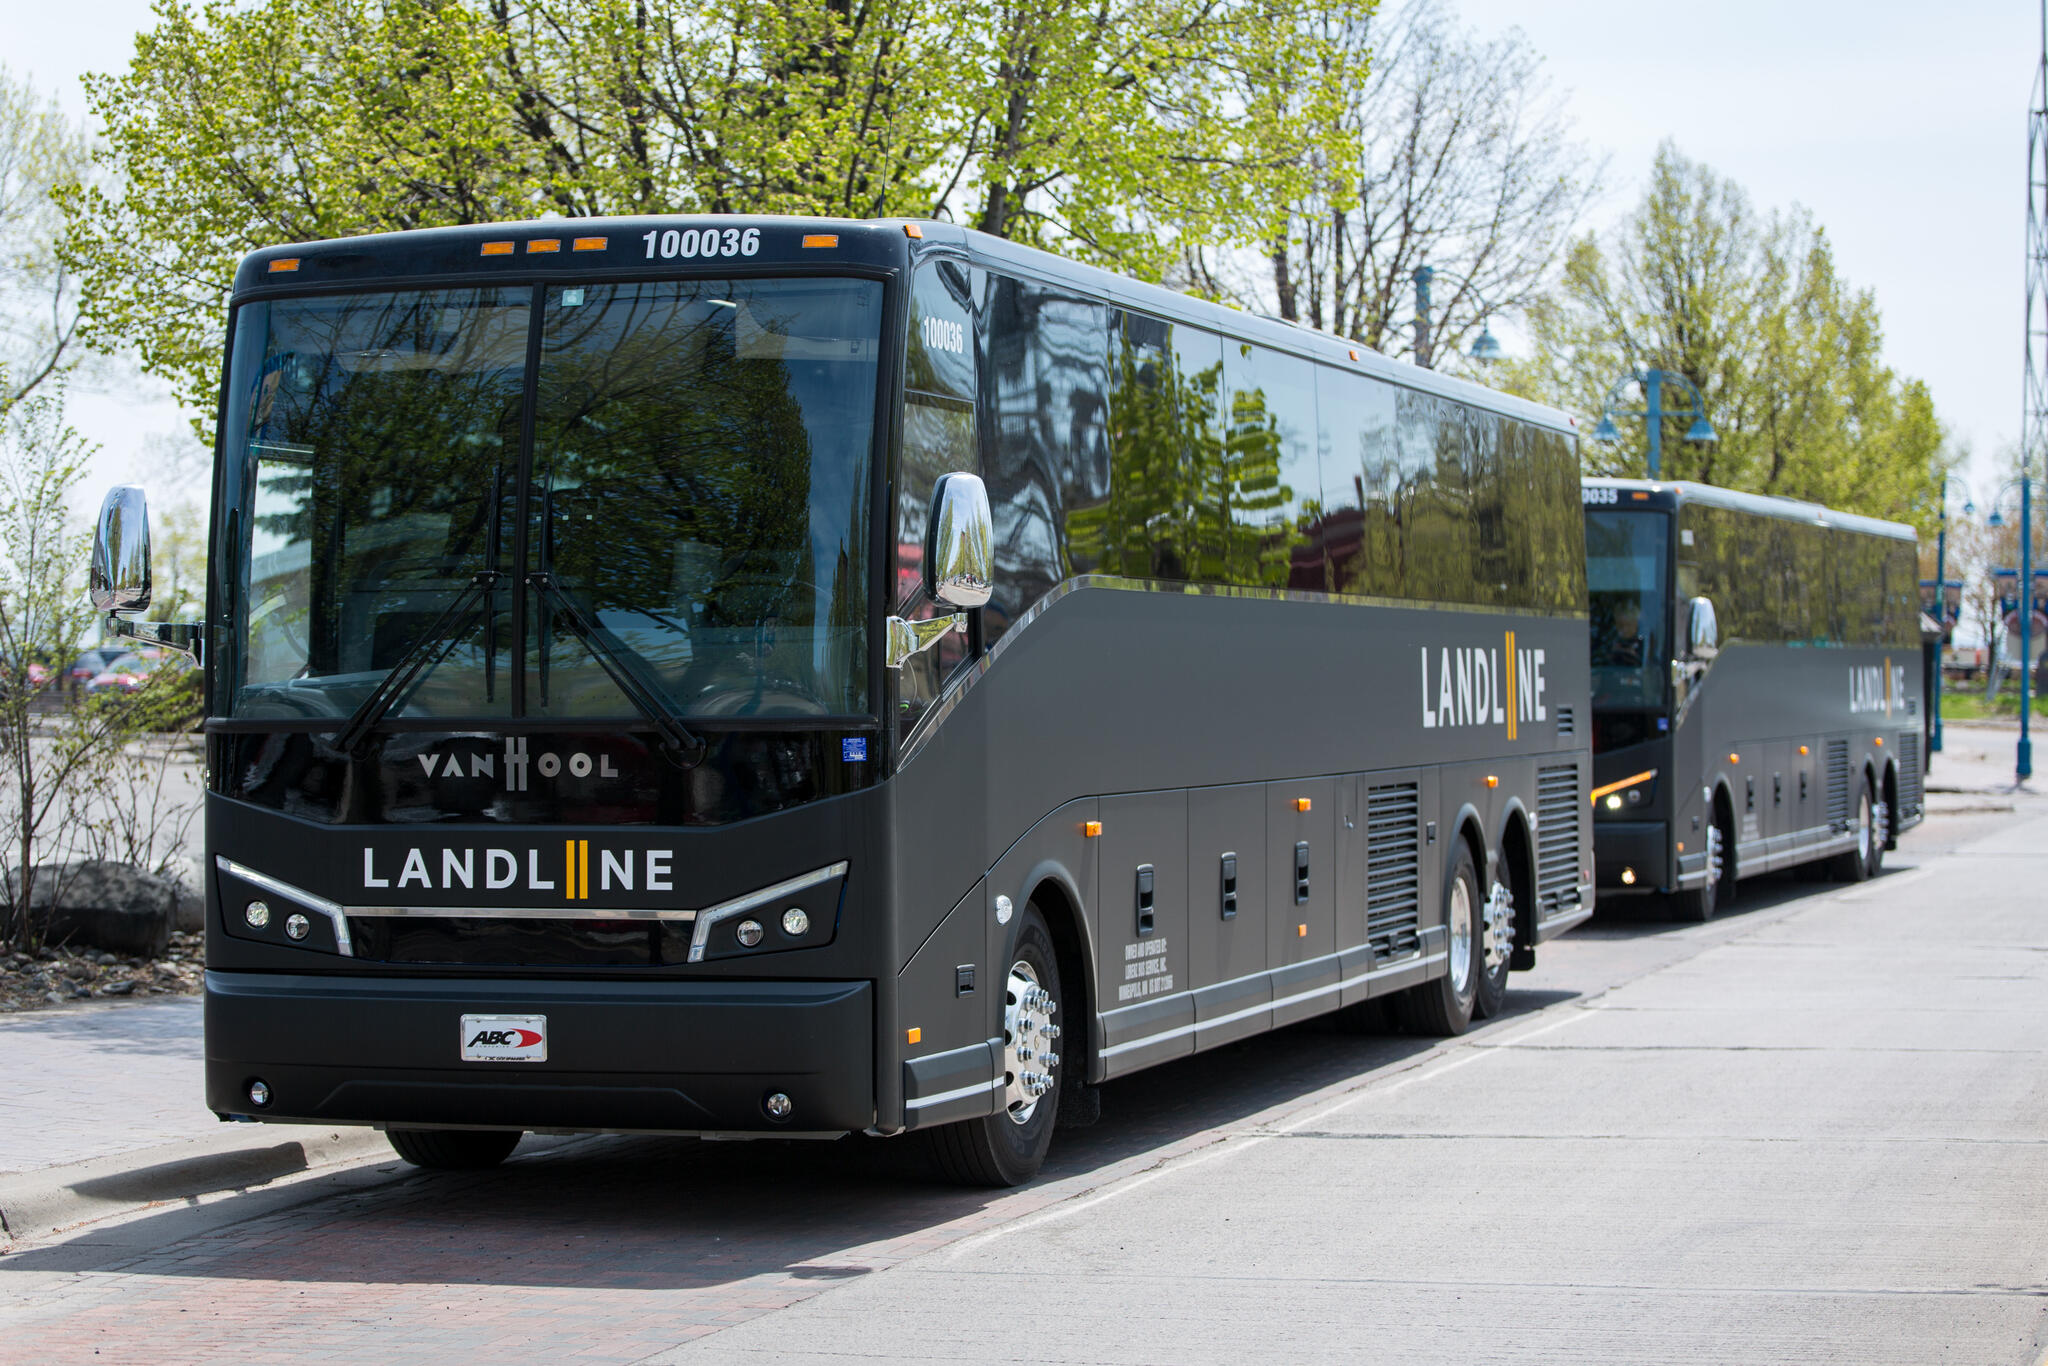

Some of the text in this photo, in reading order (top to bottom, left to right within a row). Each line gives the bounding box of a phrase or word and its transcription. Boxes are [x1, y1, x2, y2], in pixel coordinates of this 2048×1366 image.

[642, 227, 761, 259] 100036
[923, 315, 964, 355] 100036
[467, 1030, 516, 1048] ABC
